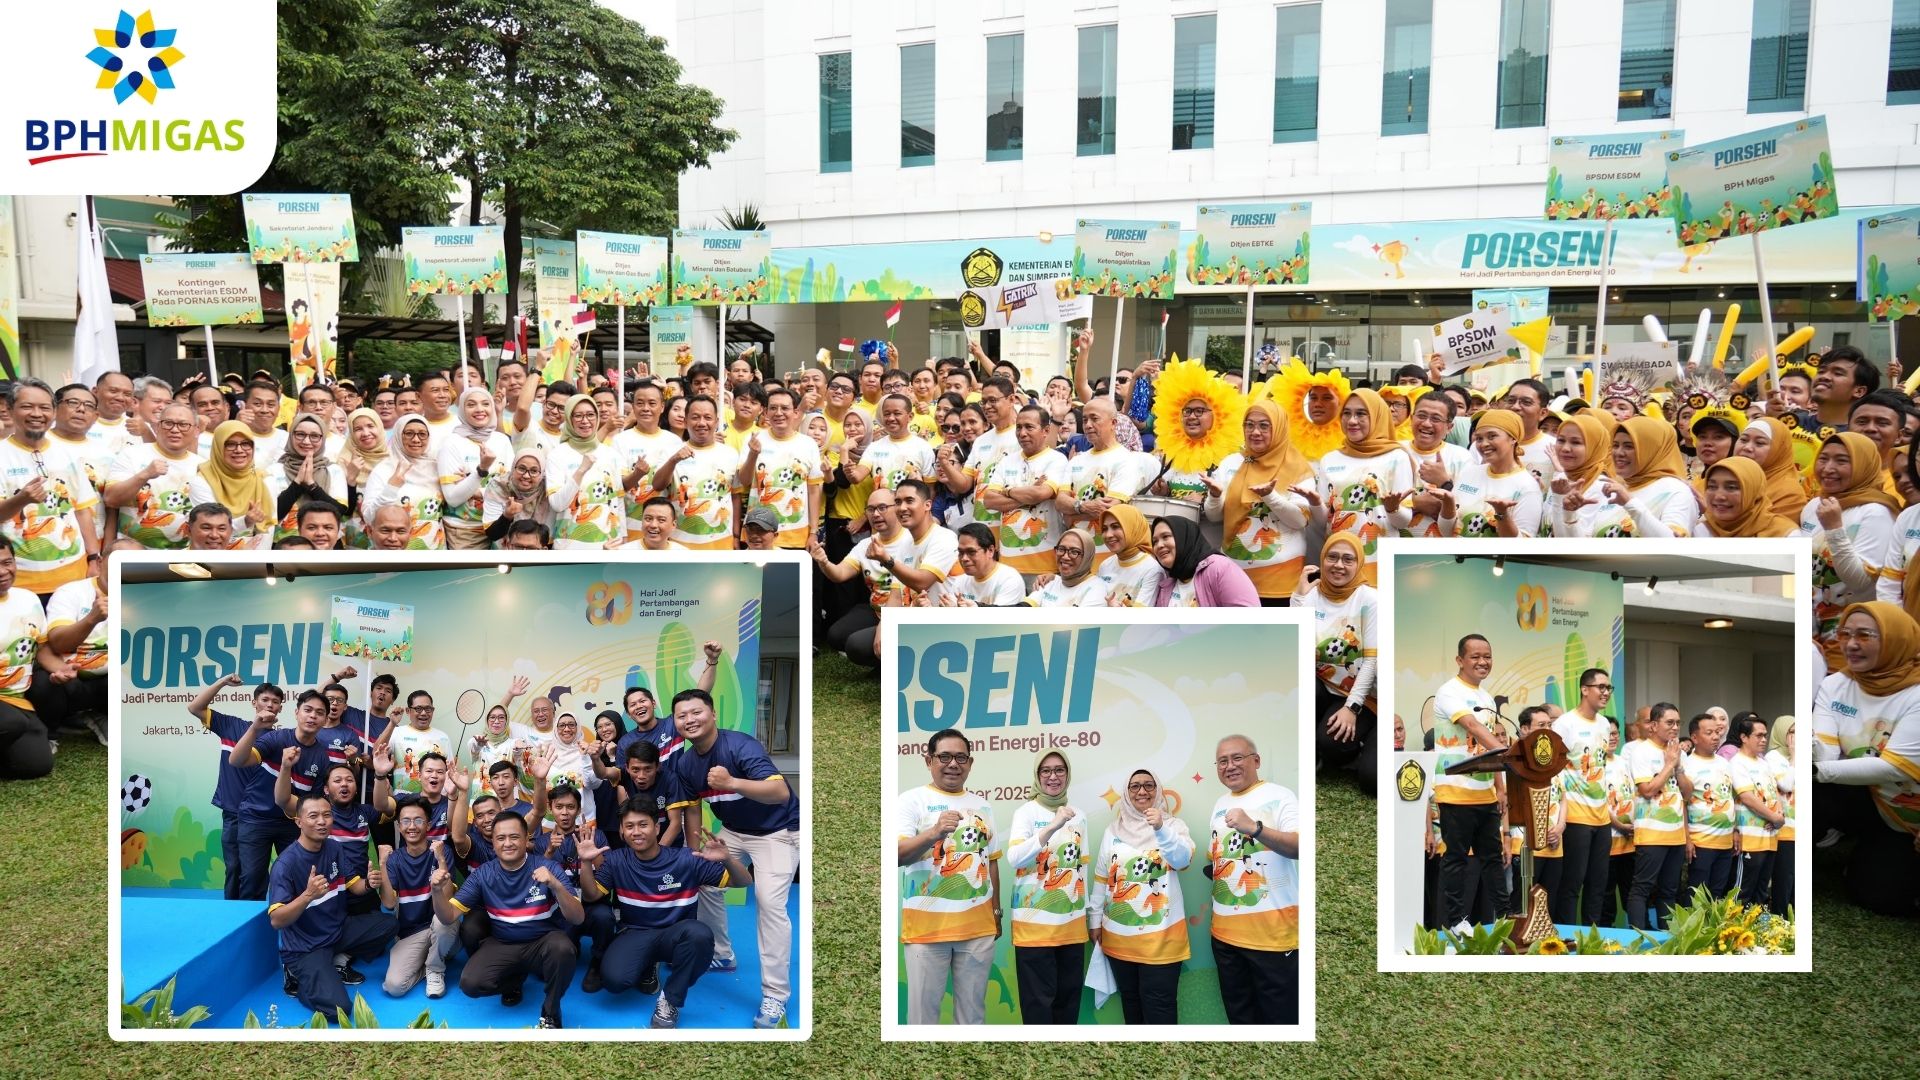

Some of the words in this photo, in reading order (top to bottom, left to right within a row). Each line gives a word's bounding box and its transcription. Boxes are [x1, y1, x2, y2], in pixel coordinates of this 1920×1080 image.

[1588, 142, 1642, 157] PORSENI
[1714, 139, 1777, 167] PORSENI
[1586, 172, 1615, 181] BPSDM
[1616, 171, 1641, 180] ESDM
[1724, 181, 1744, 192] BPH
[1746, 175, 1775, 189] Migas
[278, 201, 320, 213] PORSENI
[1230, 213, 1276, 226] PORSENI
[434, 234, 473, 246] PORSENI
[1105, 228, 1147, 241] PORSENI
[605, 241, 640, 255] PORSENI
[703, 238, 742, 250] PORSENI
[1230, 240, 1250, 248] Ditjen
[1461, 229, 1618, 269] PORSENI
[1115, 250, 1134, 258] Ditjen
[185, 260, 216, 269] PORSENI
[713, 258, 731, 266] Ditjen
[1009, 260, 1063, 270] KEMENTERIAN
[1097, 258, 1150, 267] Ketenagalistrikan
[542, 266, 569, 278] PORSENI
[1009, 273, 1025, 283] DAN
[1494, 270, 1550, 278] Pertambangan
[1567, 269, 1592, 277] Energi
[178, 278, 226, 288] Kontingen
[157, 288, 218, 296] Kementerian
[220, 287, 248, 295] ESDM
[1004, 283, 1037, 305] GATRIK
[152, 297, 176, 306] Pada
[178, 296, 219, 305] PORNAS
[221, 296, 258, 304] KORPRI
[657, 332, 686, 343] PORSENI
[1447, 325, 1497, 349] BPSDM
[1455, 340, 1495, 359] ESDM
[640, 589, 657, 597] Hari
[658, 588, 676, 598] Jadi
[639, 598, 700, 608] Pertambangan
[357, 605, 390, 619] PORSENI
[639, 609, 655, 617] dan
[656, 608, 682, 618] Energi
[1552, 607, 1590, 618] Pertambangan
[121, 692, 146, 704] Jadi
[230, 691, 250, 703] dan
[142, 725, 183, 737] Jakarta,
[184, 725, 195, 735] 13
[989, 733, 1045, 753] Energi
[1049, 731, 1101, 749] ke-80
[994, 785, 1032, 801] 2025
